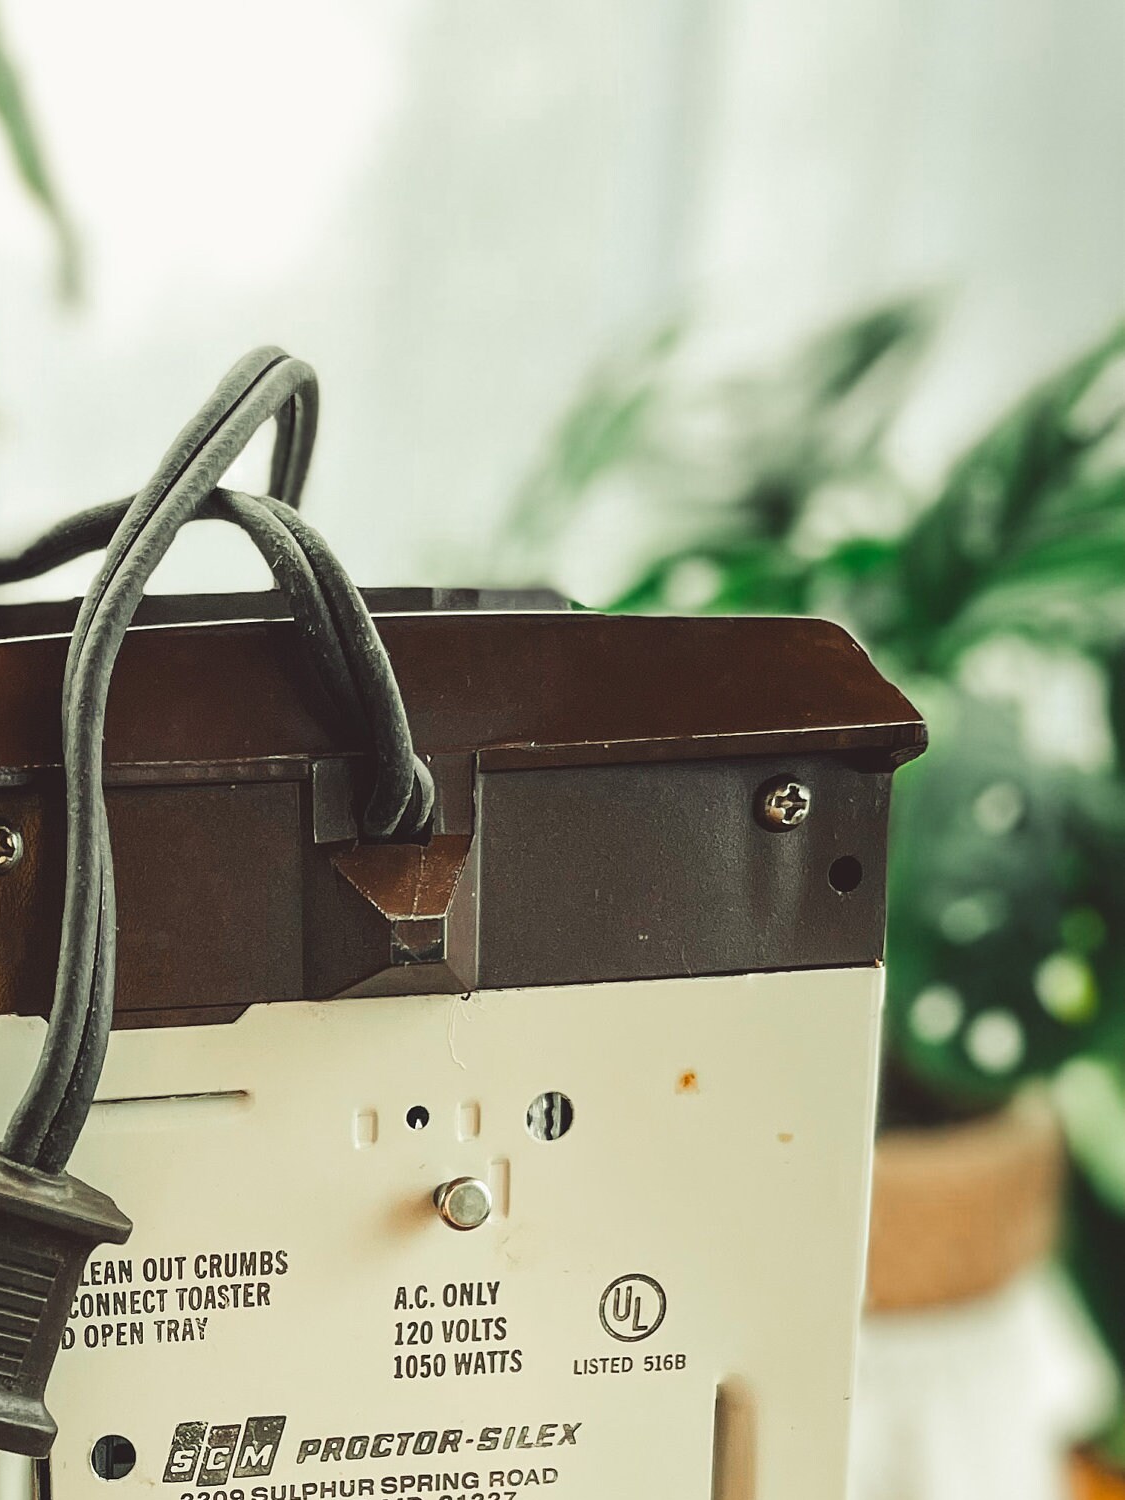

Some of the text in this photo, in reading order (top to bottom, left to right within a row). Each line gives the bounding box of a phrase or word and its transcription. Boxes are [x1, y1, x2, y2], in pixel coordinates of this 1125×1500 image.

[143, 1256, 186, 1282] OUT
[194, 1250, 288, 1279] CRUMBS
[175, 1282, 270, 1311] TOASTER
[394, 1281, 500, 1310] A.C. ONLY
[83, 1320, 143, 1348] OPEN
[153, 1317, 208, 1343] TRAY
[394, 1317, 507, 1345] 120 VOLTS
[394, 1349, 522, 1379] 1050 WATTS
[574, 1354, 686, 1375] LISTED 516B
[296, 1423, 582, 1464] PROCTOR-SILEX
[380, 1472, 479, 1494] SPRING
[489, 1468, 558, 1487] ROAD
